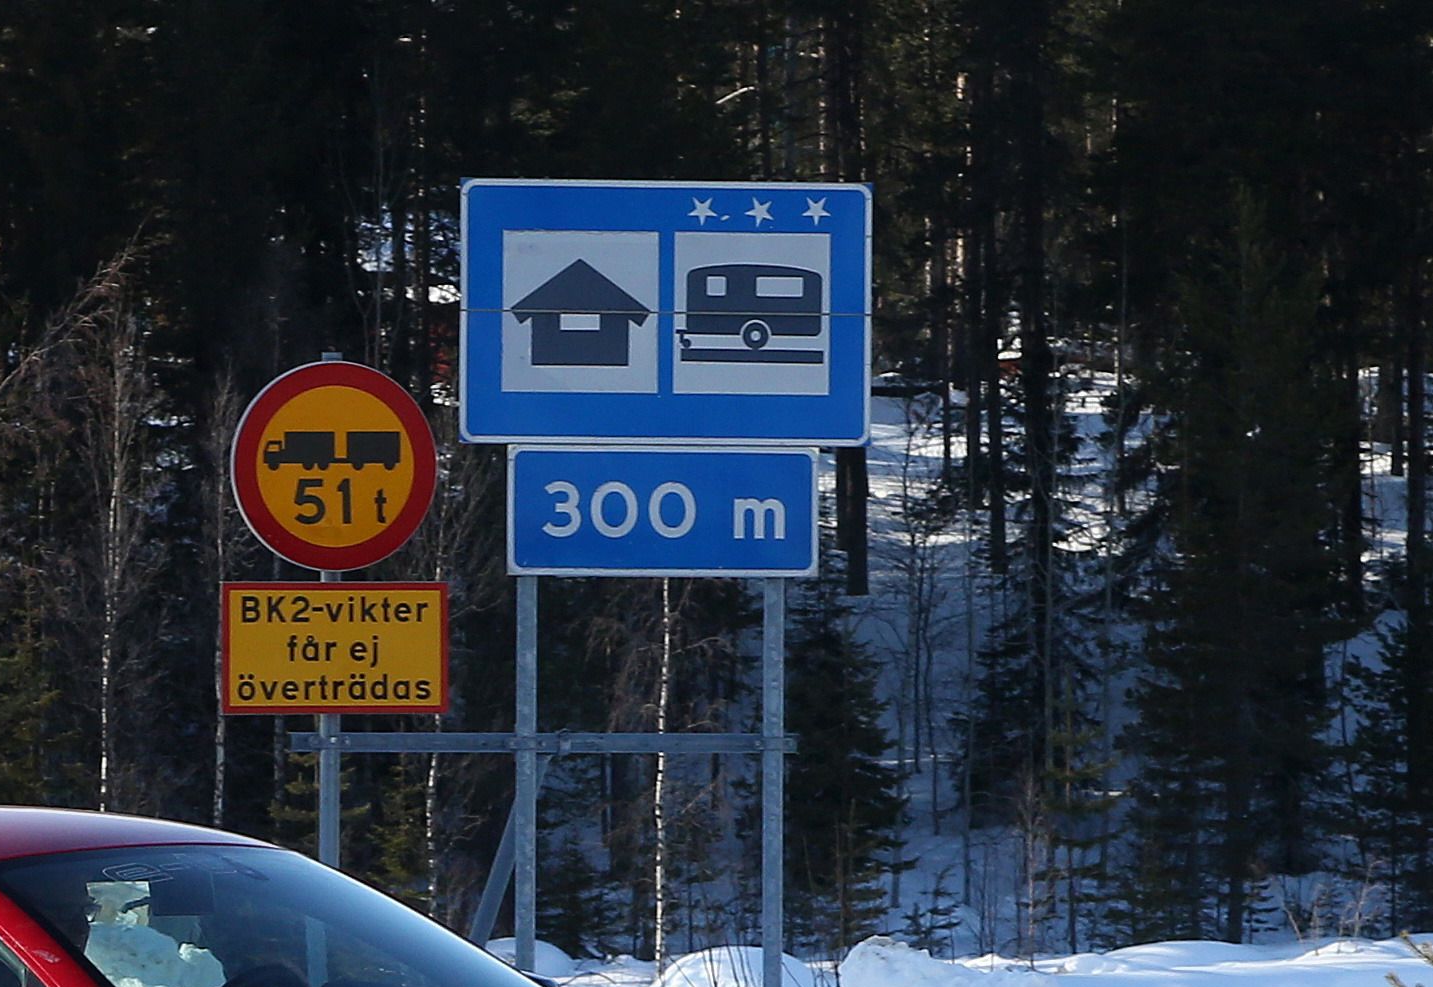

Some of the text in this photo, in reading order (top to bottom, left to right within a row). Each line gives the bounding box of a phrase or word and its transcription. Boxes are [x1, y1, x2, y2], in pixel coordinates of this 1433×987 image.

[294, 478, 388, 525] 51 t
[542, 481, 785, 540] 300 m
[240, 595, 430, 624] BK2-vikter
[286, 634, 380, 669] får ej
[236, 673, 432, 702] överträdas
